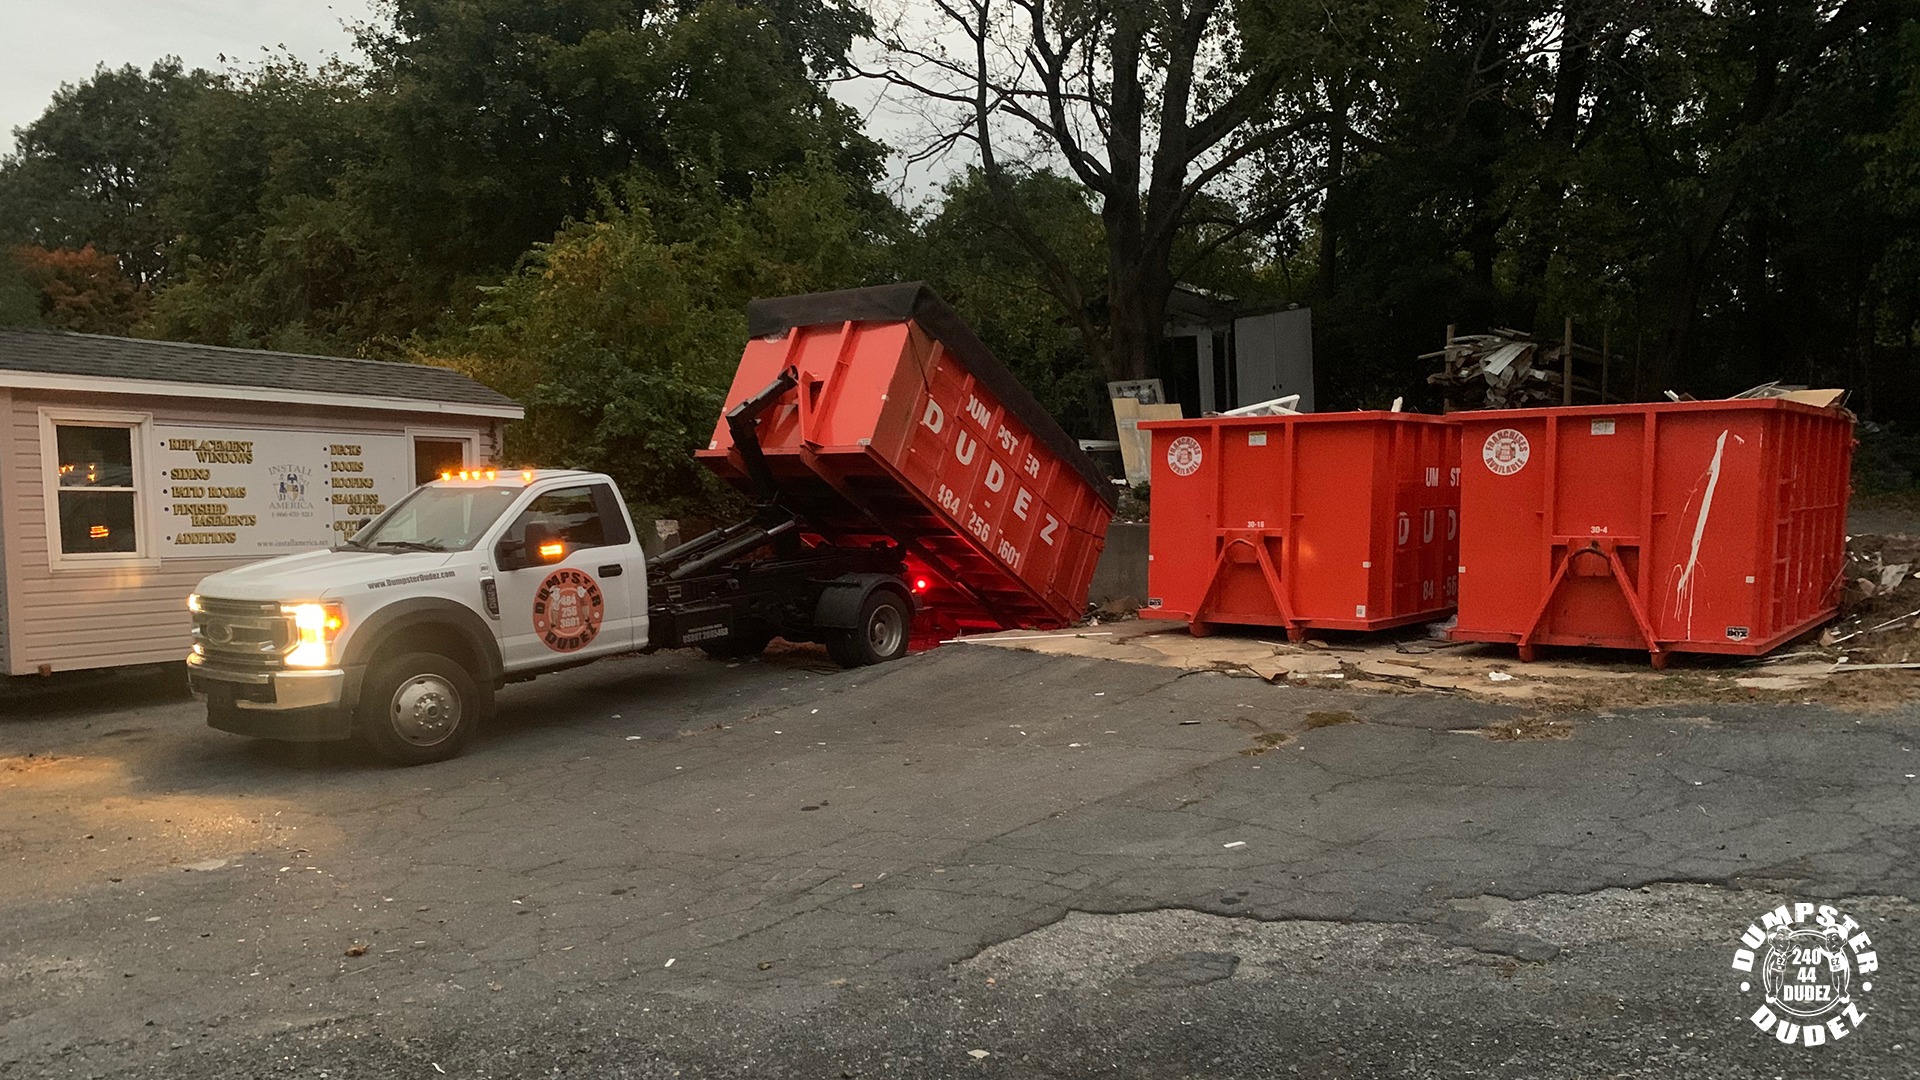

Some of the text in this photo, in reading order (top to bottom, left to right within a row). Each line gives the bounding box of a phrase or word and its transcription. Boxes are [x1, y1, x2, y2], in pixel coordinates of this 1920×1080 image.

[168, 439, 254, 453] REPLACEMENT
[1485, 431, 1528, 452] FRANCHISES
[329, 444, 362, 456] DECKS
[196, 452, 253, 464] WINDOWS
[268, 464, 313, 476] INSTALL
[330, 461, 364, 472] DOORS
[1486, 457, 1525, 473] AVAILABLE
[170, 468, 211, 481] SIDING
[922, 399, 1059, 546] DUDEZ
[331, 477, 374, 489] ROOFING
[171, 486, 247, 498] PATIO ROOMS
[331, 494, 379, 505] SEAMLESS
[172, 503, 229, 516] FINISHED
[191, 515, 257, 527] BASEMENTS
[1590, 525, 1608, 534] 30-4
[174, 532, 237, 545] ADDITIONS
[367, 570, 456, 590] www.DumpsterDudez.com
[535, 571, 601, 615] DUMPSTER
[545, 622, 597, 650] DUDEZ
